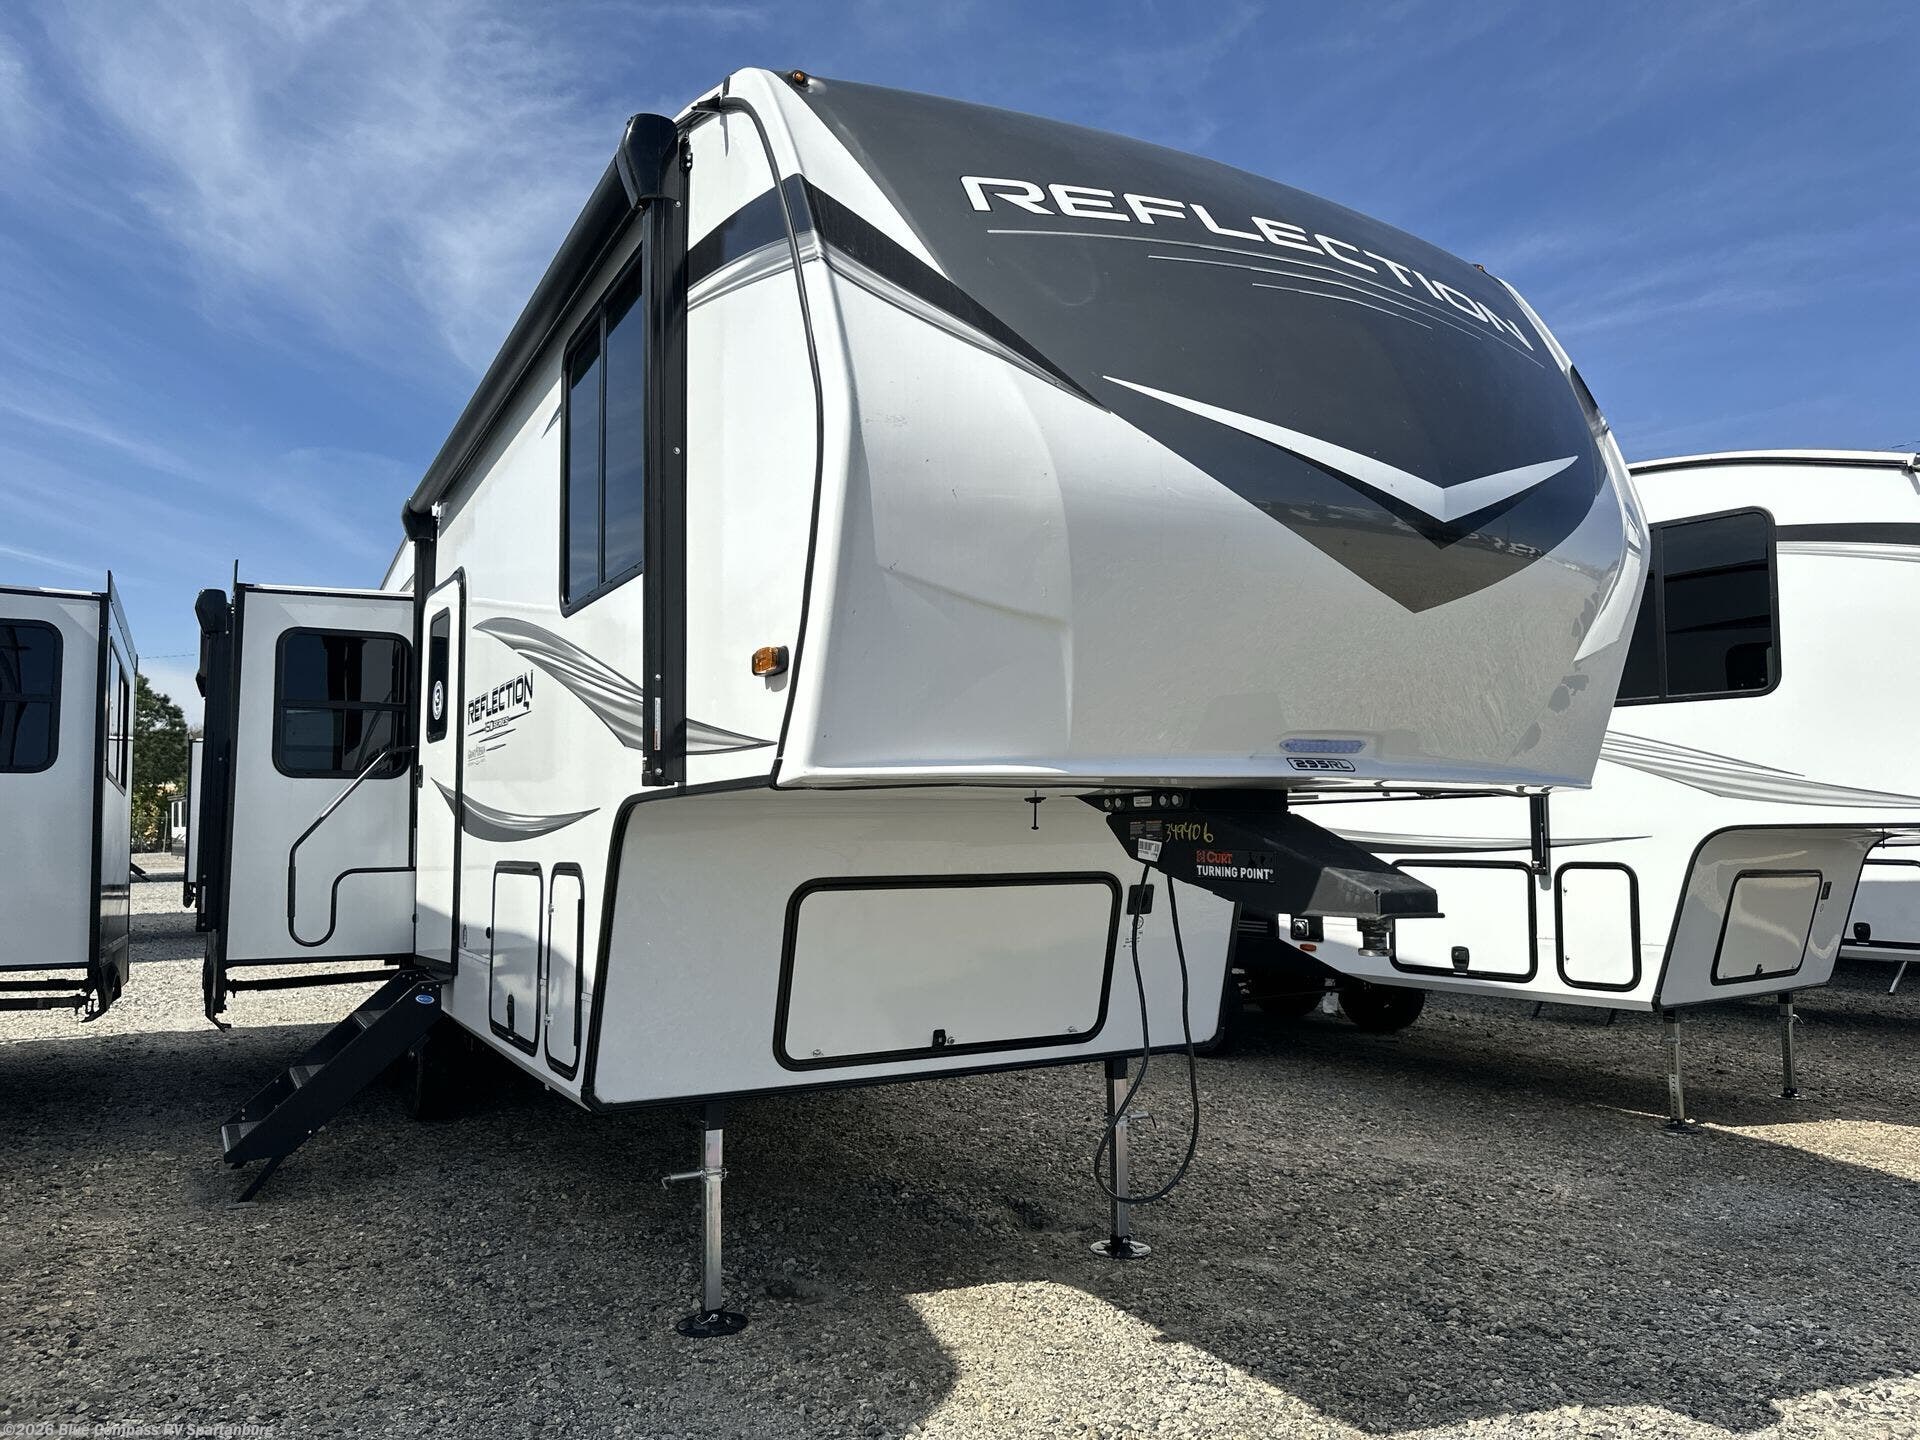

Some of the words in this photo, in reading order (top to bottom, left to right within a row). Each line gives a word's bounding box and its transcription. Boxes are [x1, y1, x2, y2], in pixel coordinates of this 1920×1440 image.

[960, 175, 1534, 351] REFLECTION
[467, 669, 534, 725] REFLECTION
[1293, 759, 1351, 770] 295RL
[1206, 851, 1233, 864] CURT
[1196, 864, 1238, 878] TURNING
